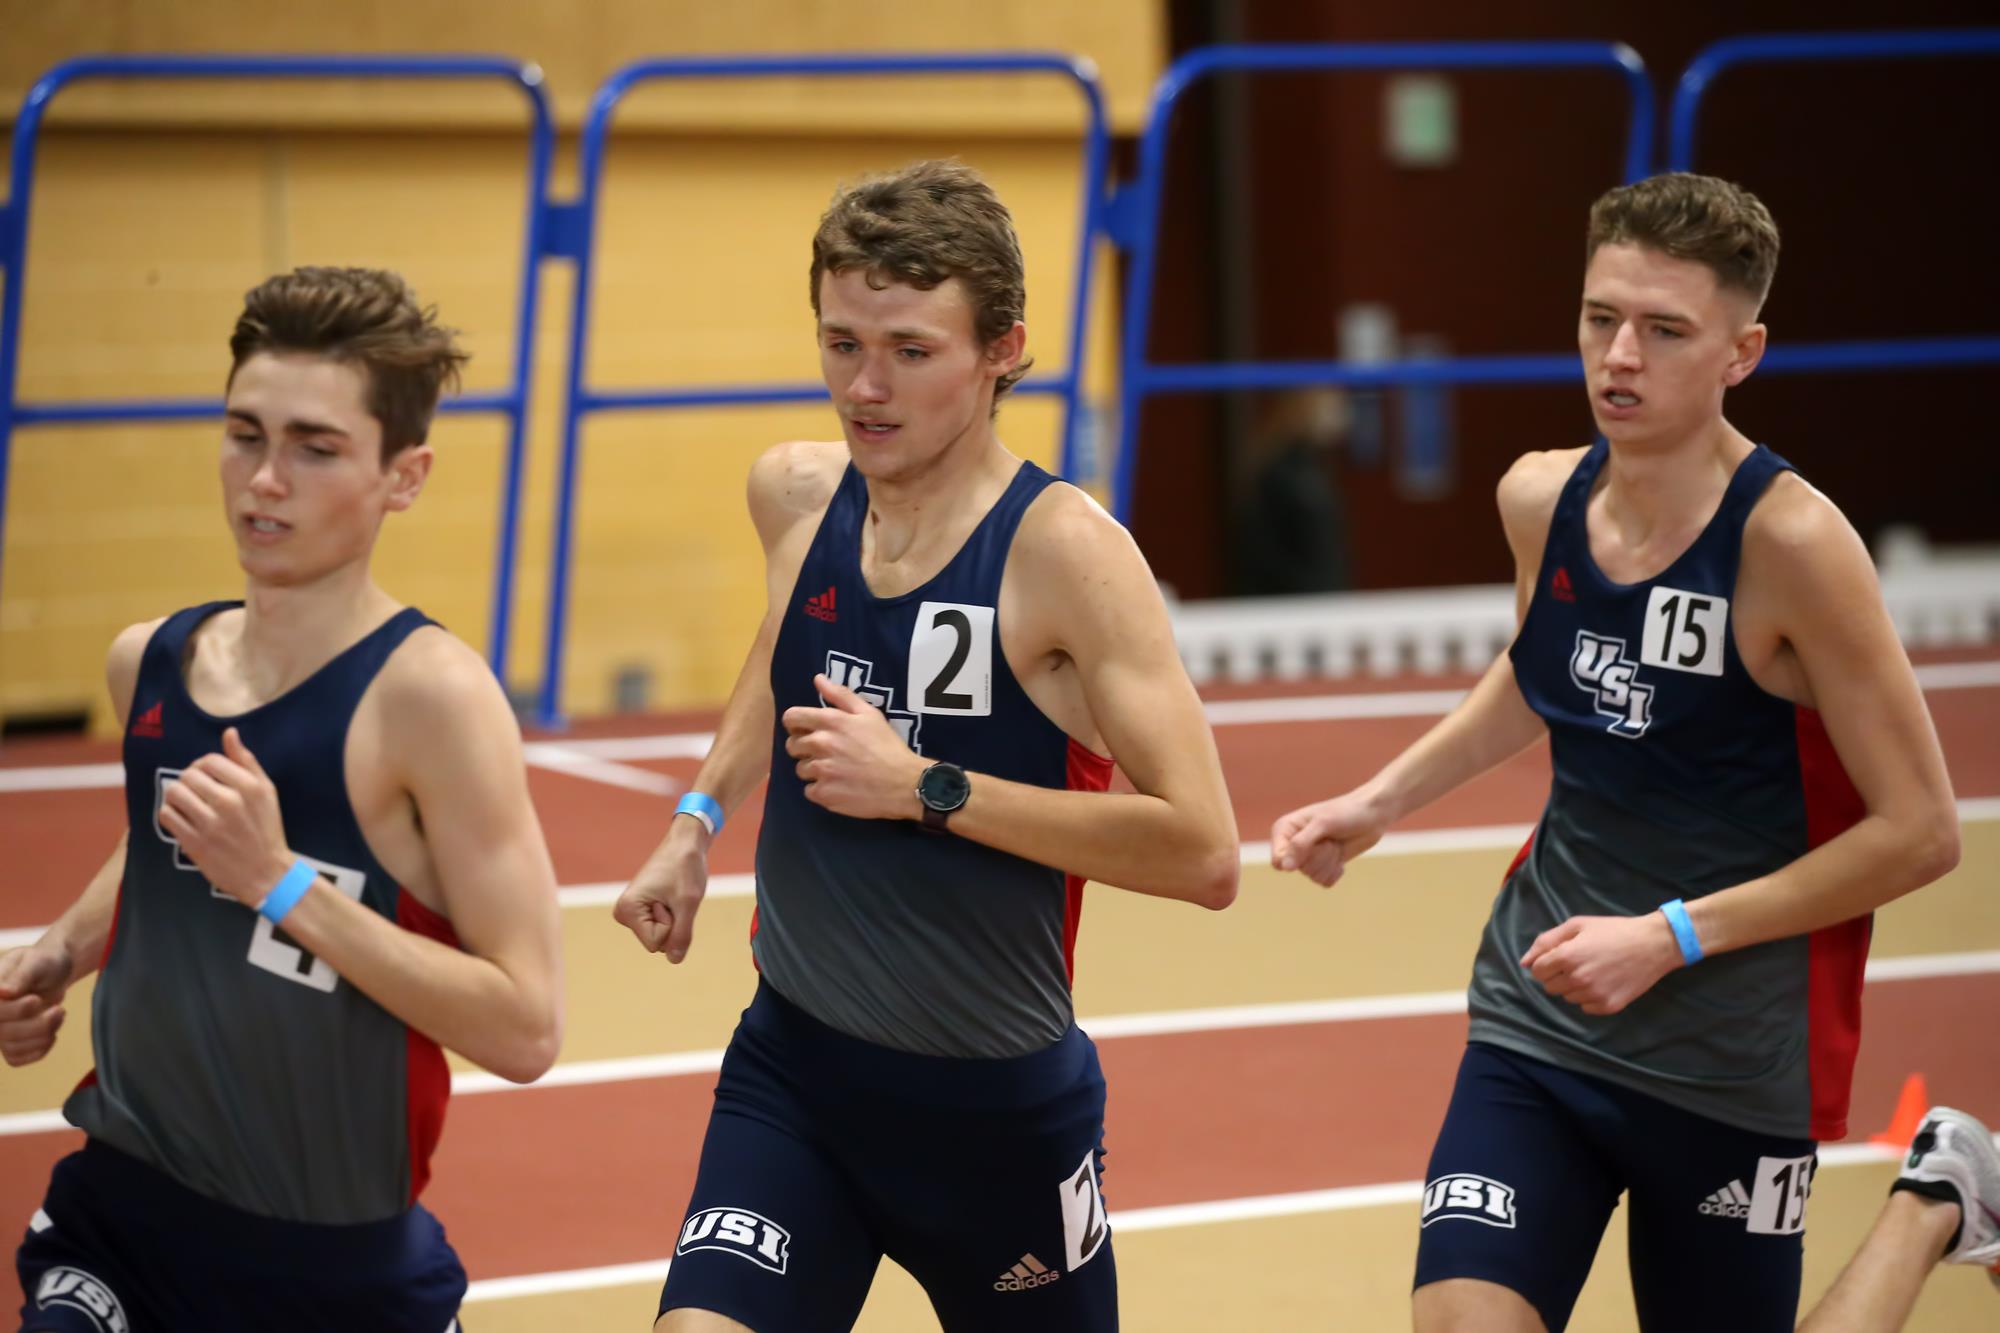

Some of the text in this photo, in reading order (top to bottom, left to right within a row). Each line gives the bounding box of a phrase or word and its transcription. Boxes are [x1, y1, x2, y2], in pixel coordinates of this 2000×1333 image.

[923, 609, 973, 710] 2
[1660, 594, 1712, 668] 15
[1574, 637, 1650, 729] USI
[1074, 1163, 1104, 1260] 2
[1422, 1177, 1509, 1220] USI
[1697, 1201, 1751, 1219] adida
[1771, 1161, 1808, 1231] 15
[679, 1211, 783, 1264] USI
[993, 1269, 1060, 1292] adidas
